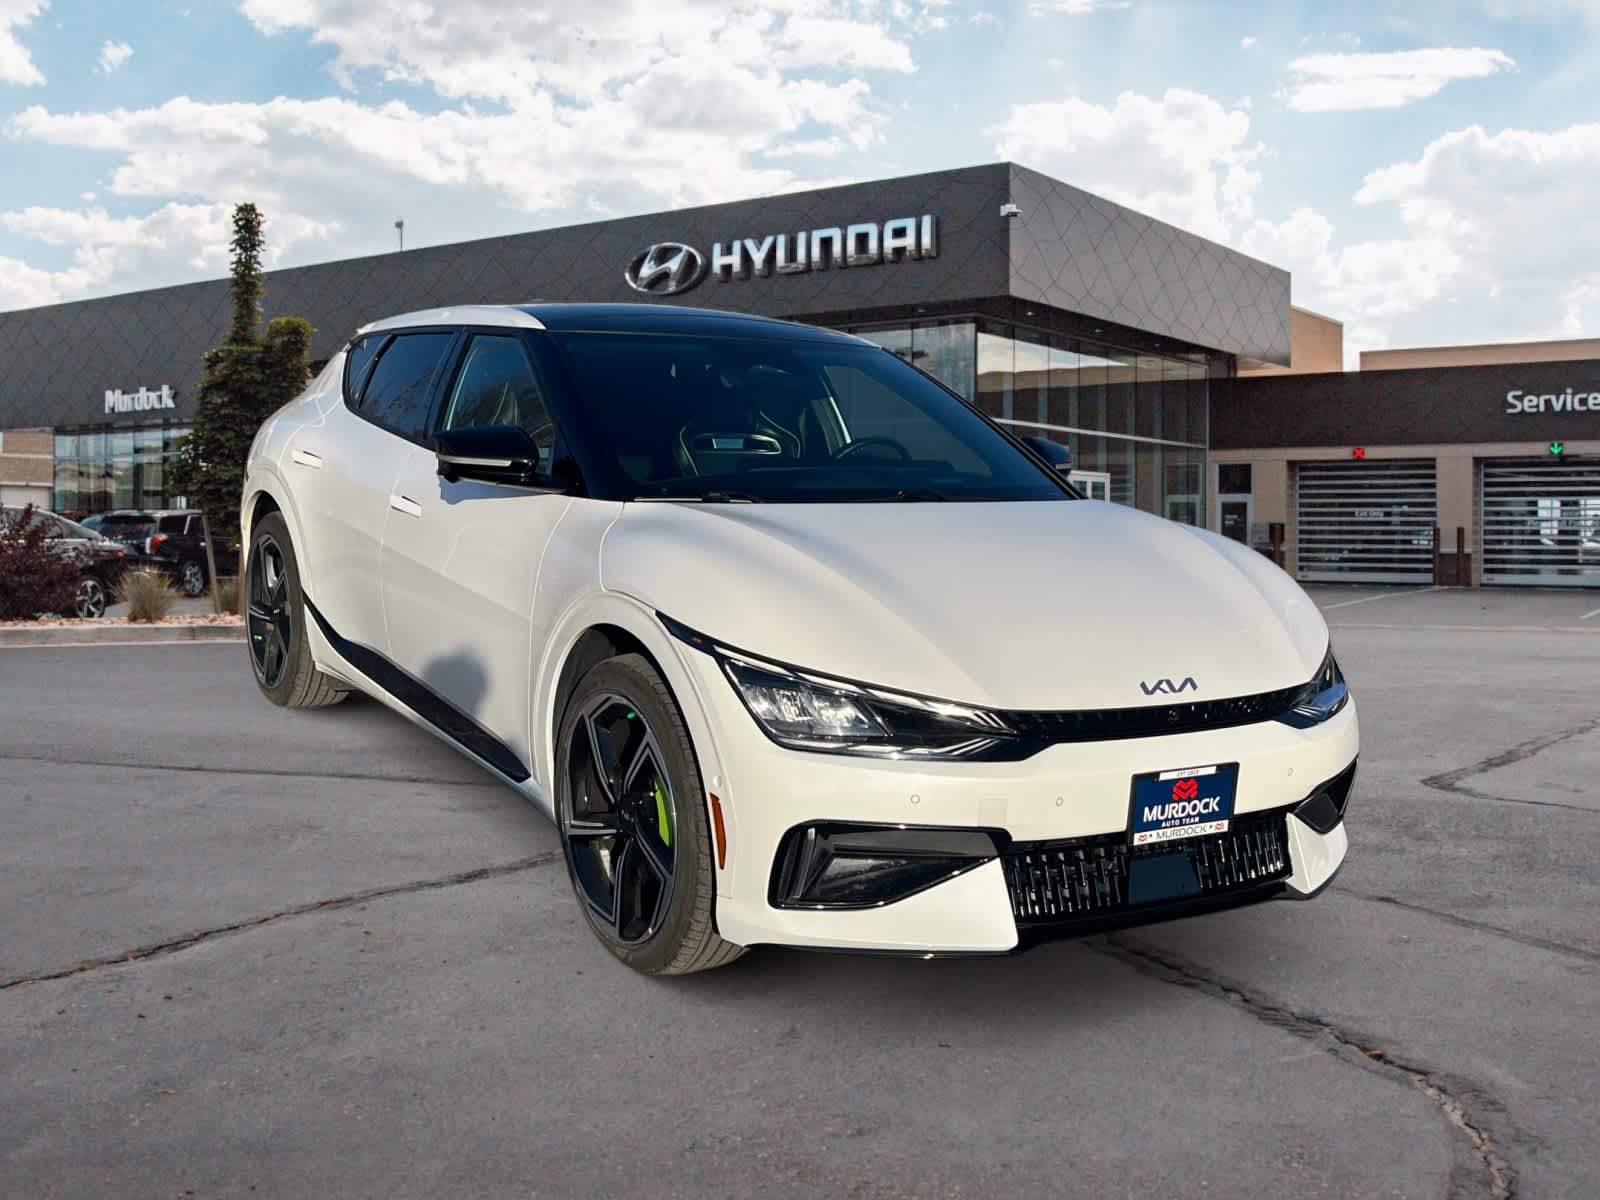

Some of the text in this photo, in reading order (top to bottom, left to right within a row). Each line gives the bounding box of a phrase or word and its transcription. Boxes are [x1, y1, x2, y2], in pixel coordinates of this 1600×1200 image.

[711, 214, 936, 282] HYUNDAI
[104, 384, 176, 413] Murdock
[1505, 387, 1600, 413] Service
[1140, 677, 1198, 695] KIA
[1143, 796, 1221, 823] MURDOCK
[1161, 815, 1200, 827] AUTO TEAM
[1156, 825, 1208, 840] MURDOCK
